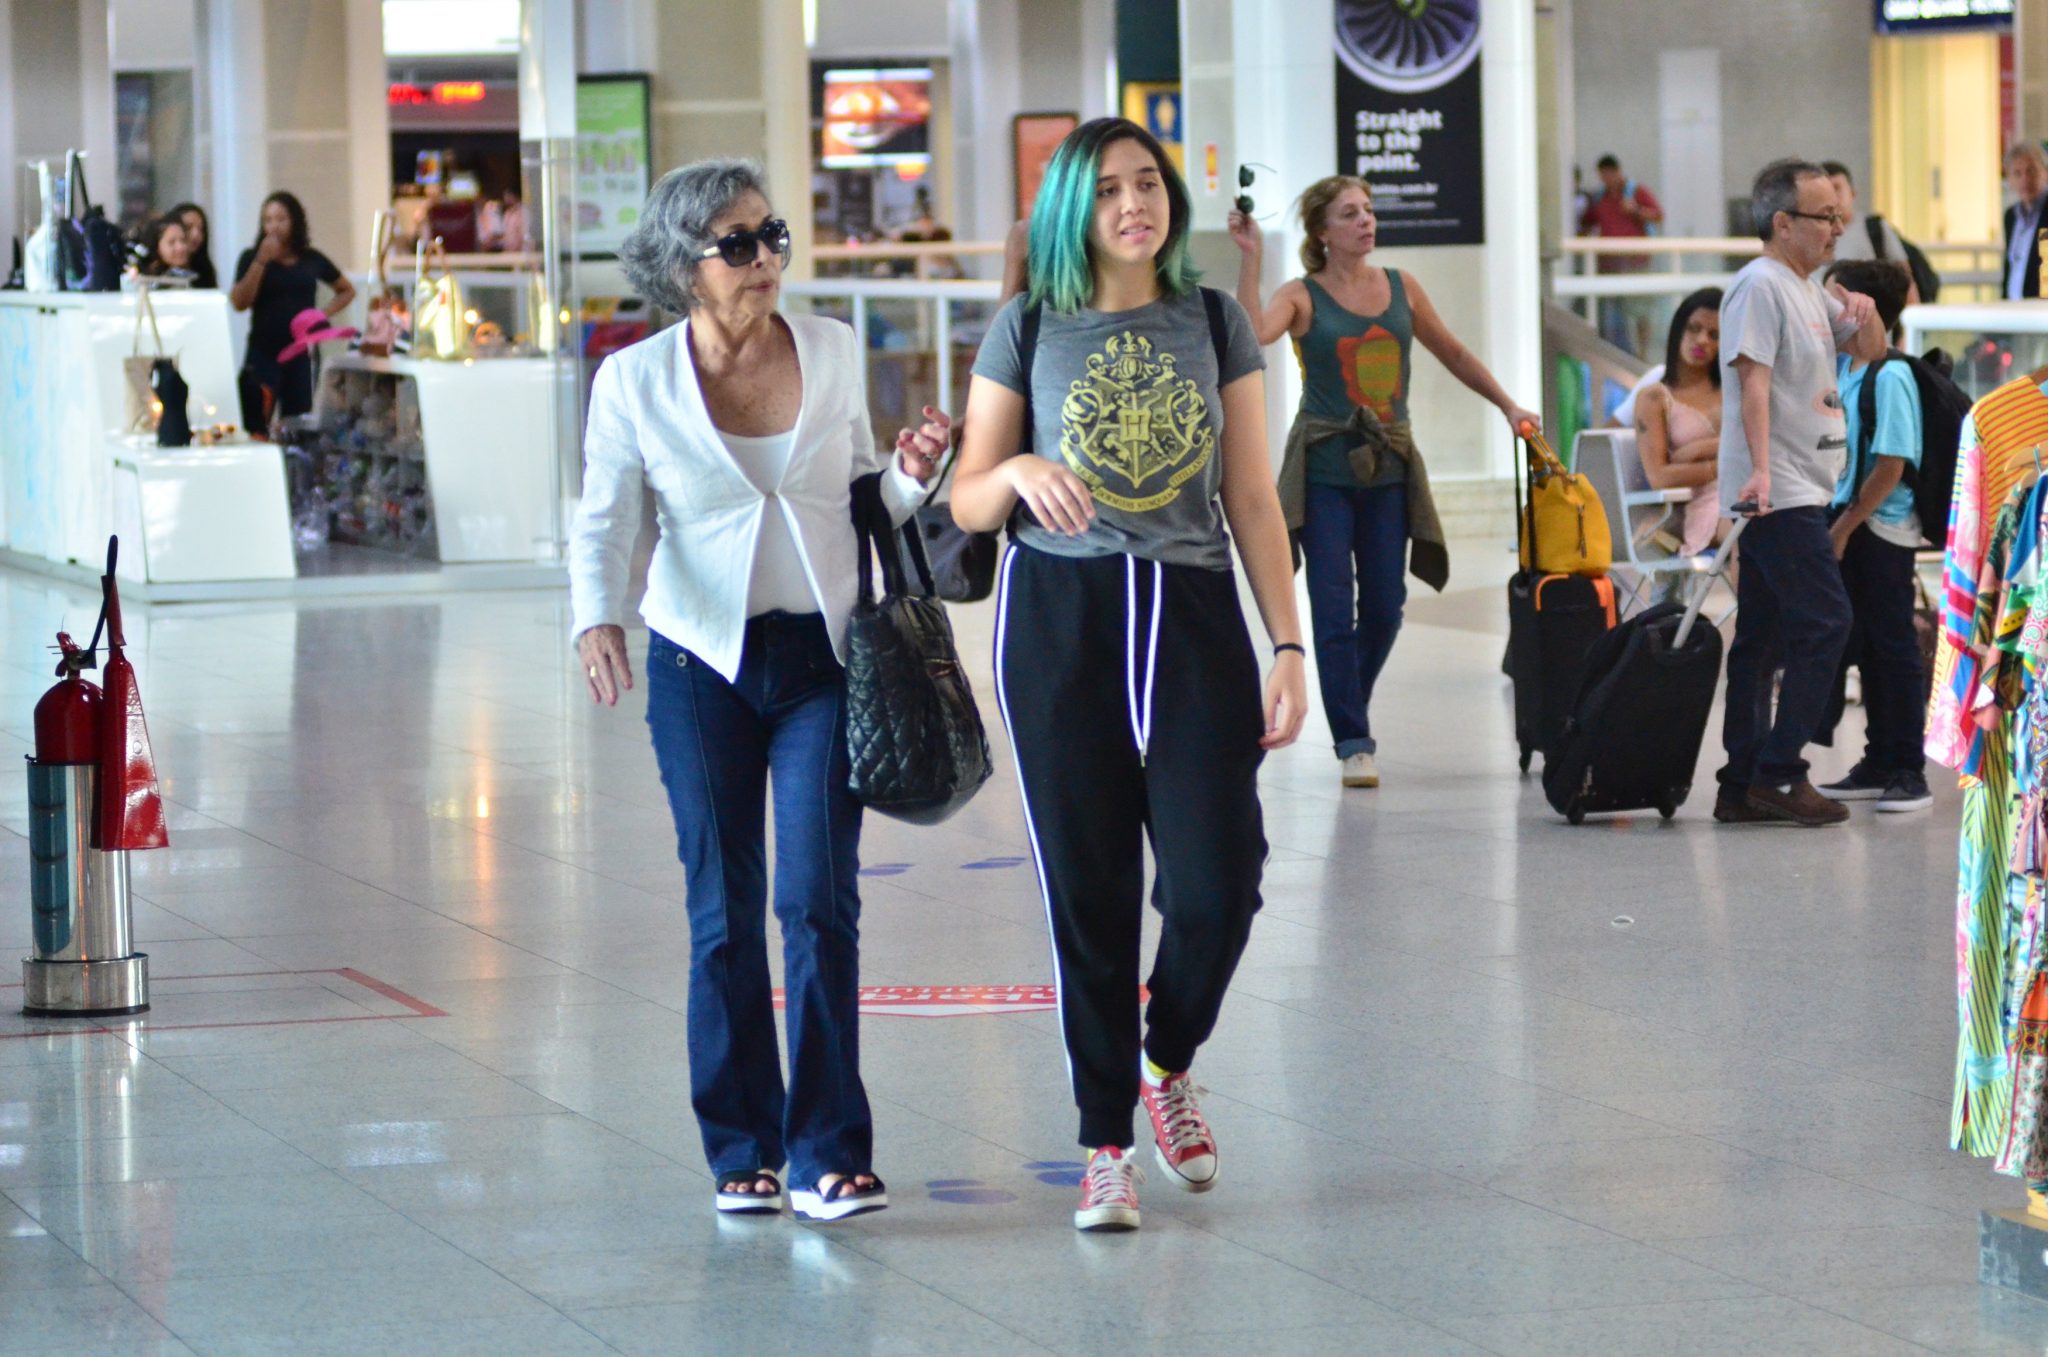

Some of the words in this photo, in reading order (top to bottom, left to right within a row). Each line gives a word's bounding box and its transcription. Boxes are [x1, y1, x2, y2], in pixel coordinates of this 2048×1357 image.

[1355, 109, 1443, 132] Straight
[1356, 132, 1380, 151] to
[1384, 131, 1422, 151] the
[1356, 151, 1421, 176] point.
[1125, 415, 1147, 437] H
